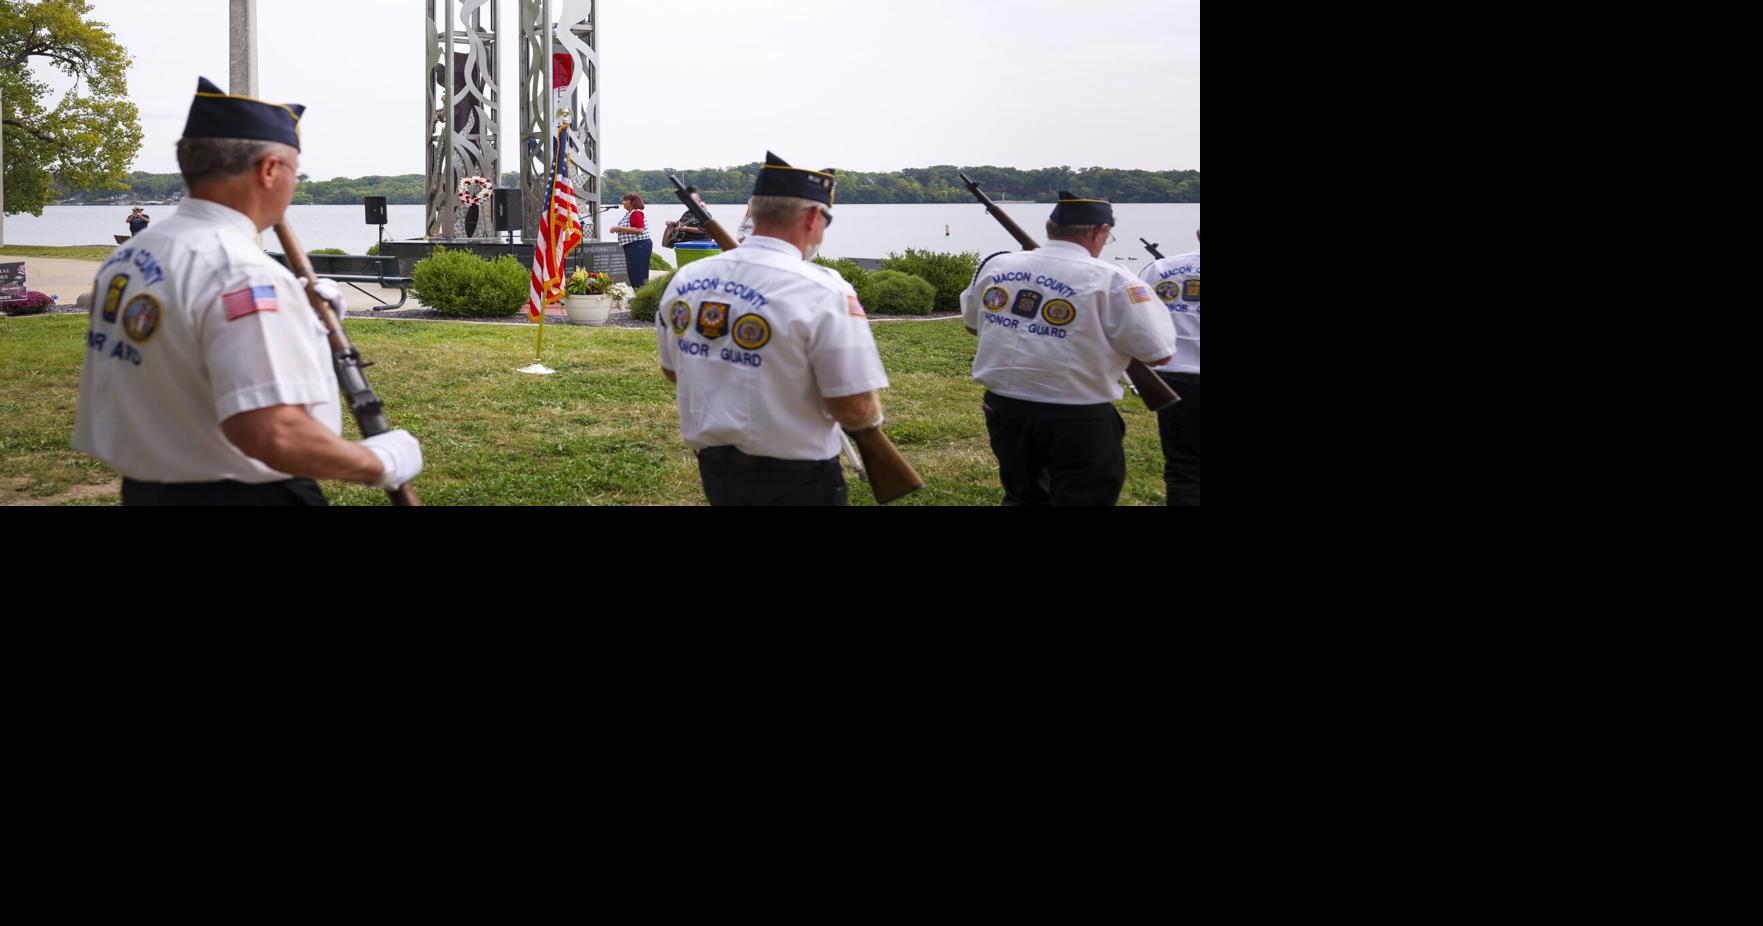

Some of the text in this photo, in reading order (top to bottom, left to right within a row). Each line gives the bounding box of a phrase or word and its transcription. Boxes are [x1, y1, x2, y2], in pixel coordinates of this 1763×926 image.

[992, 272, 1032, 284] MACON
[1036, 275, 1077, 298] COUNTY
[1160, 265, 1192, 279] MACON
[677, 278, 769, 309] MACON COUNTY
[985, 312, 1067, 339] HONOR GUARD
[720, 347, 762, 367] GUARD
